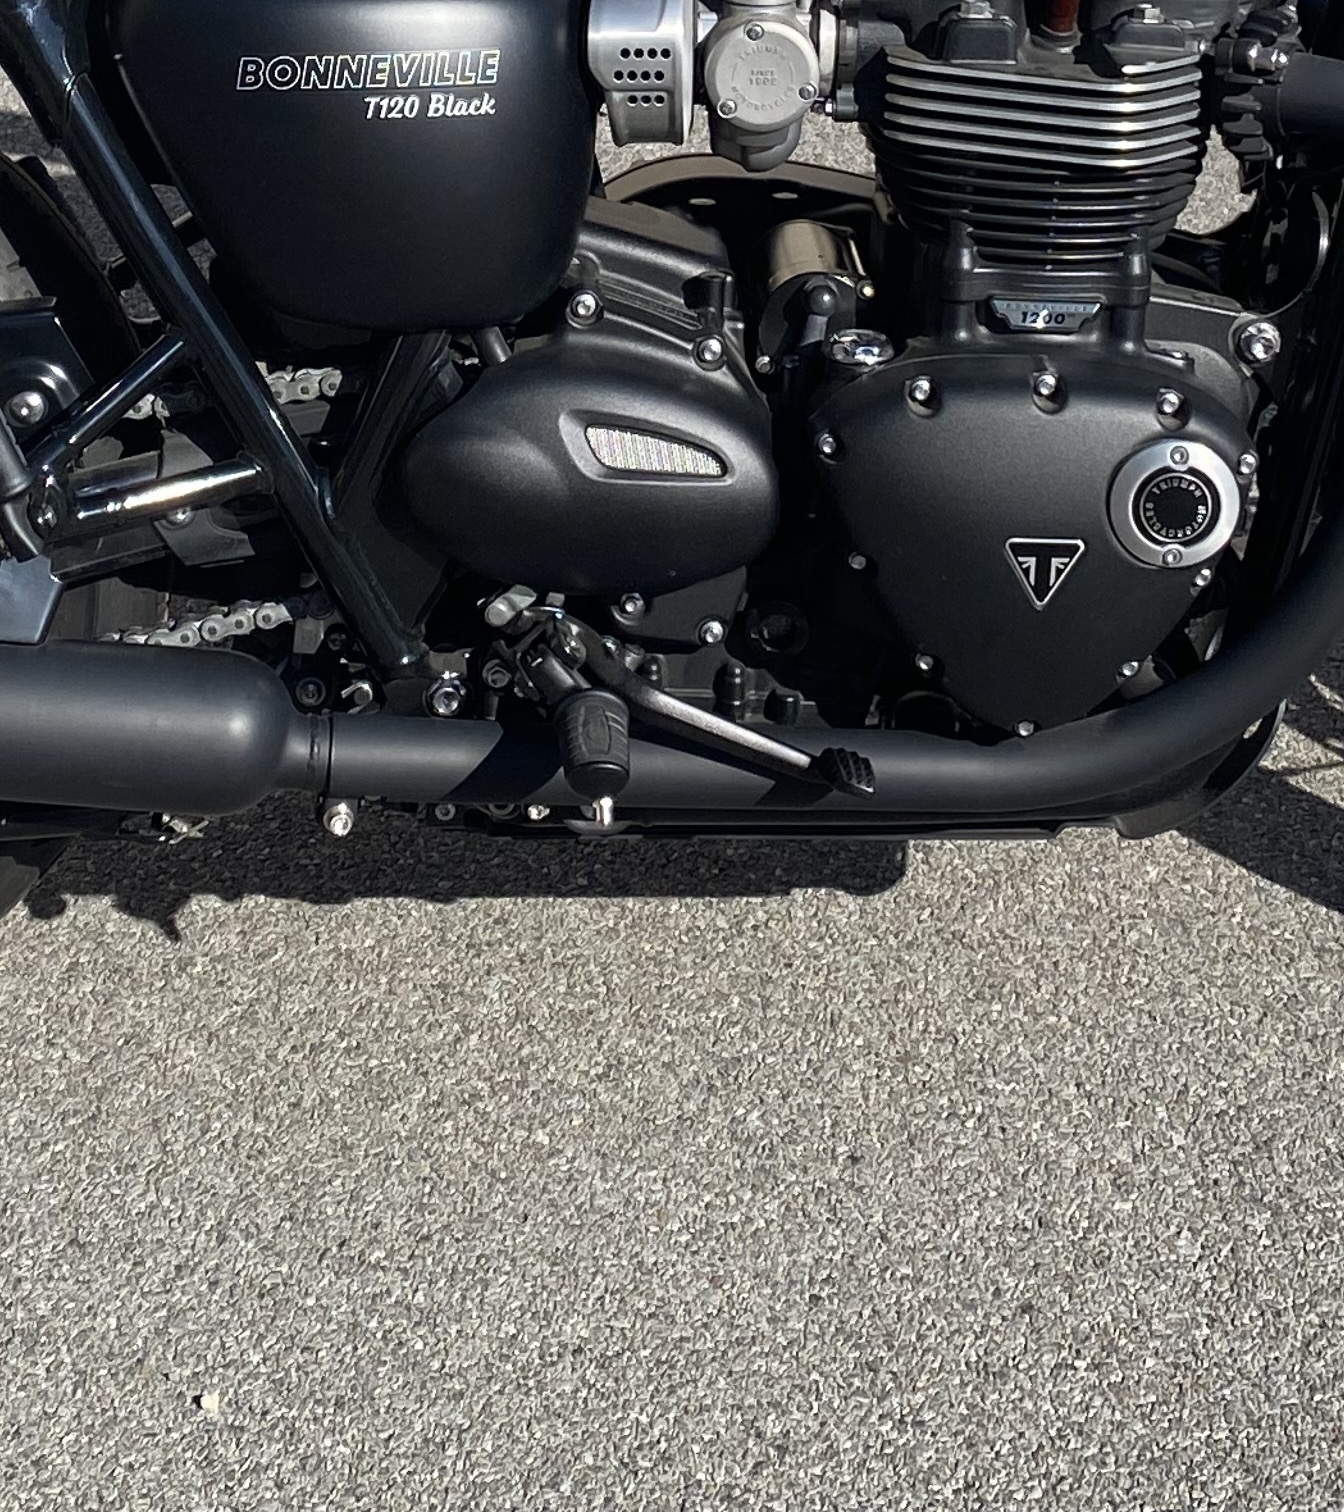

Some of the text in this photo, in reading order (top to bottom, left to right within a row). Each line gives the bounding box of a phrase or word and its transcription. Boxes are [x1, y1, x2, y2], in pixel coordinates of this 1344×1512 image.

[236, 49, 501, 90] BONNEVILLE
[363, 93, 496, 119] T120 Black
[1021, 310, 1066, 325] 1200
[1150, 478, 1204, 498] TRIUMPH
